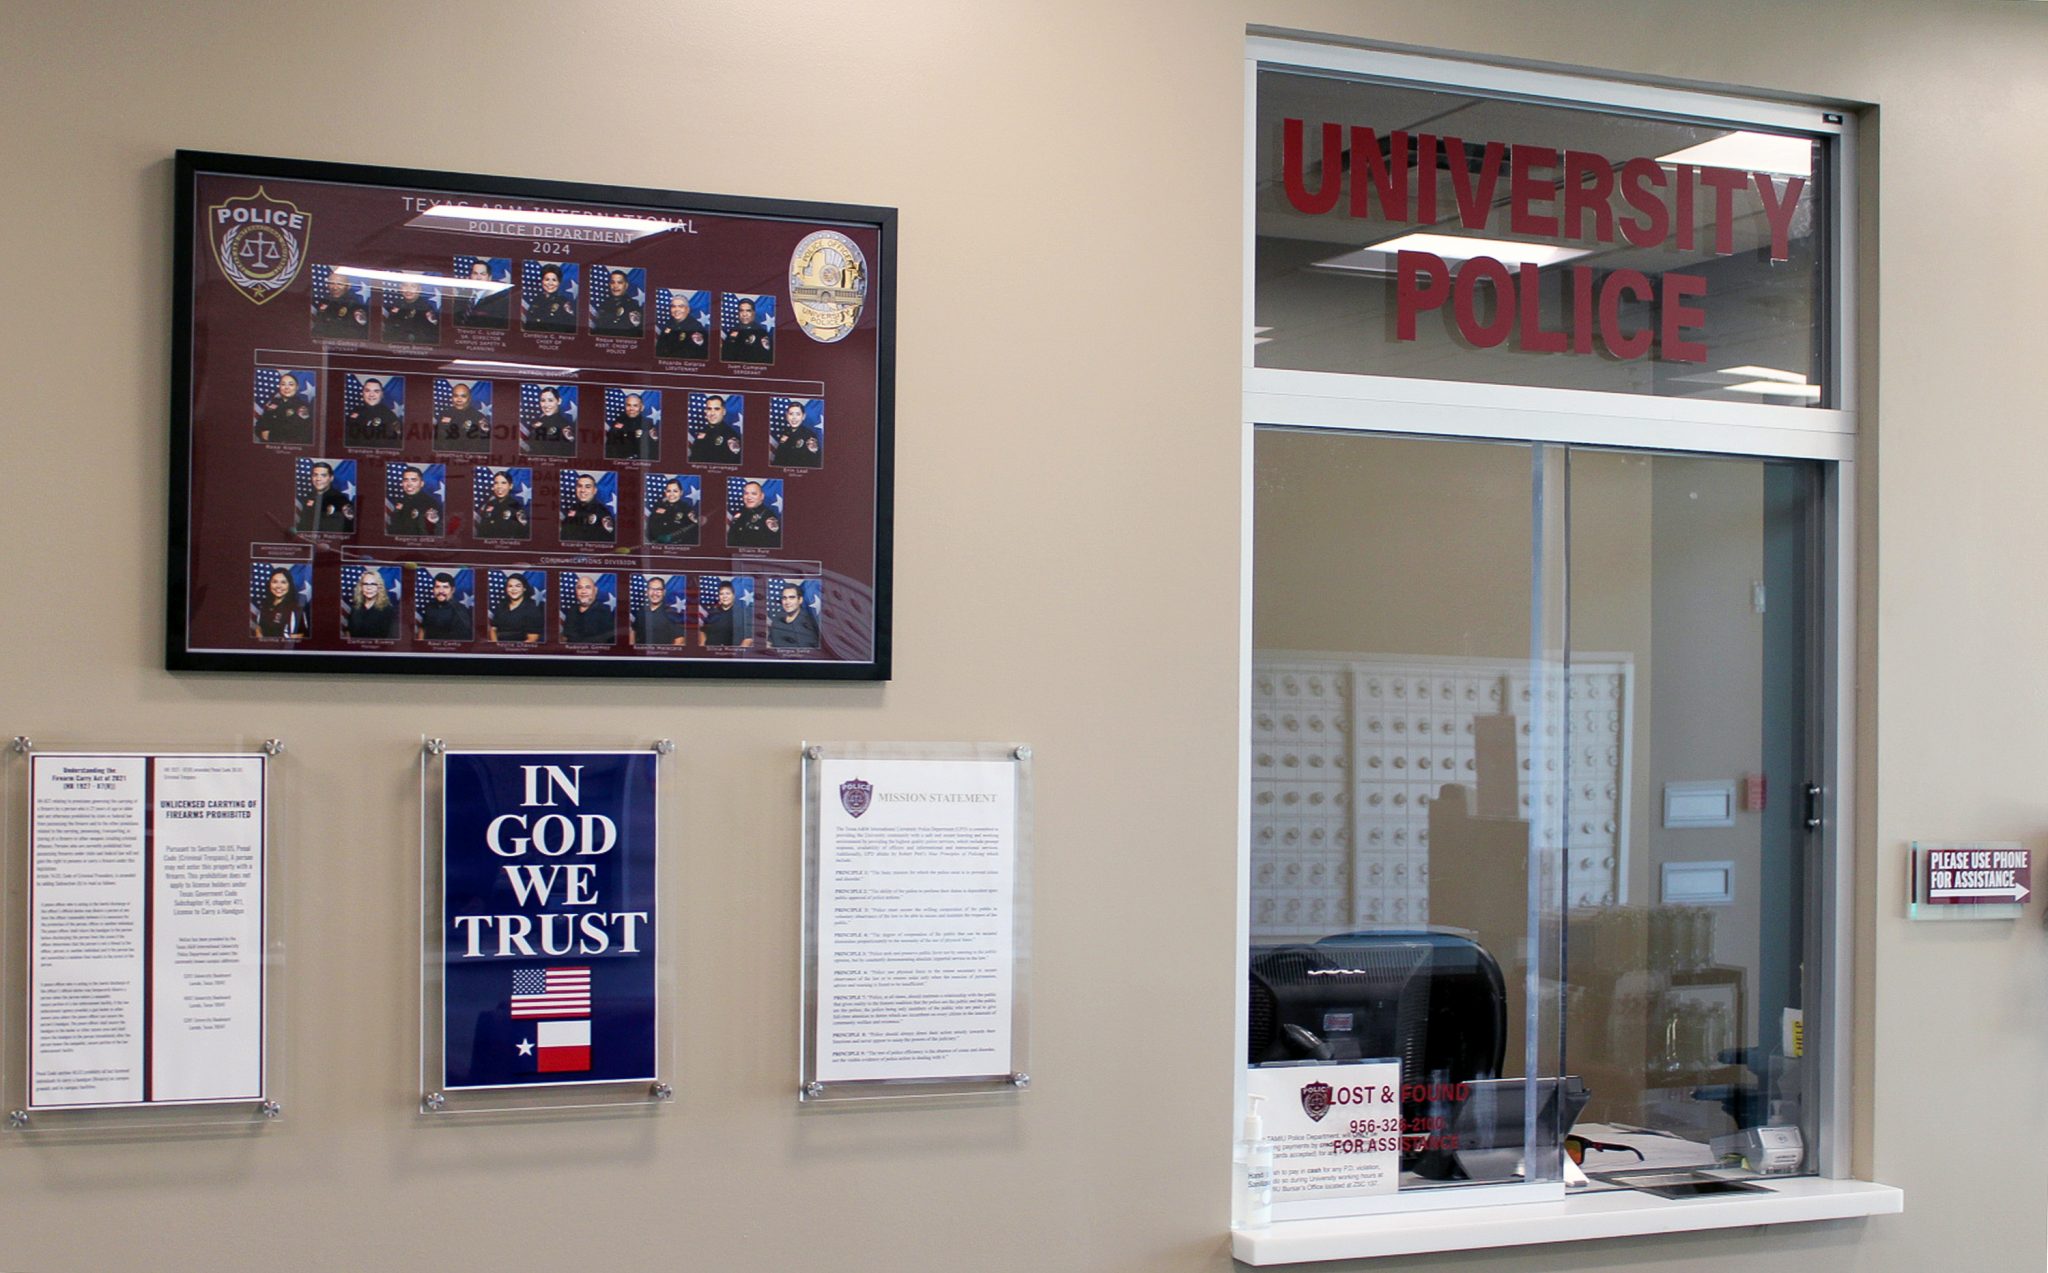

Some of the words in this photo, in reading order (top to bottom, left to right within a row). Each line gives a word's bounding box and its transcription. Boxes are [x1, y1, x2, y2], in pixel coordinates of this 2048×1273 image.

[1282, 117, 1808, 263] UNIVERSITY
[217, 207, 304, 230] POLICE
[469, 221, 526, 235] POLICE
[533, 226, 635, 244] DEPARTMENT
[533, 241, 570, 255] 2024
[1396, 250, 1708, 364] POLICE
[604, 558, 637, 566] DIVISION
[520, 765, 584, 807] IN
[160, 800, 205, 808] UNLICENSED
[207, 800, 245, 808] CARRYING
[247, 800, 256, 808] OF
[878, 792, 928, 803] MISSION
[929, 793, 998, 804] STATEMENT
[166, 810, 204, 818] FIREARMS
[206, 810, 251, 818] PROHIBITED
[486, 813, 617, 857] GOD
[1931, 851, 1969, 870] PLEASE
[1971, 851, 1991, 869] USE
[1993, 851, 2028, 868] PHONE
[502, 864, 599, 907] WE
[1931, 870, 1952, 889] FOR
[1954, 870, 2016, 888] ASSISTANCE
[455, 911, 649, 957] TRUST
[1327, 1086, 1376, 1105] LOST
[1381, 1085, 1395, 1104] &
[1402, 1083, 1471, 1103] FOUND
[1334, 1138, 1363, 1153] FOR
[1368, 1135, 1460, 1152] ASSISTANCE
